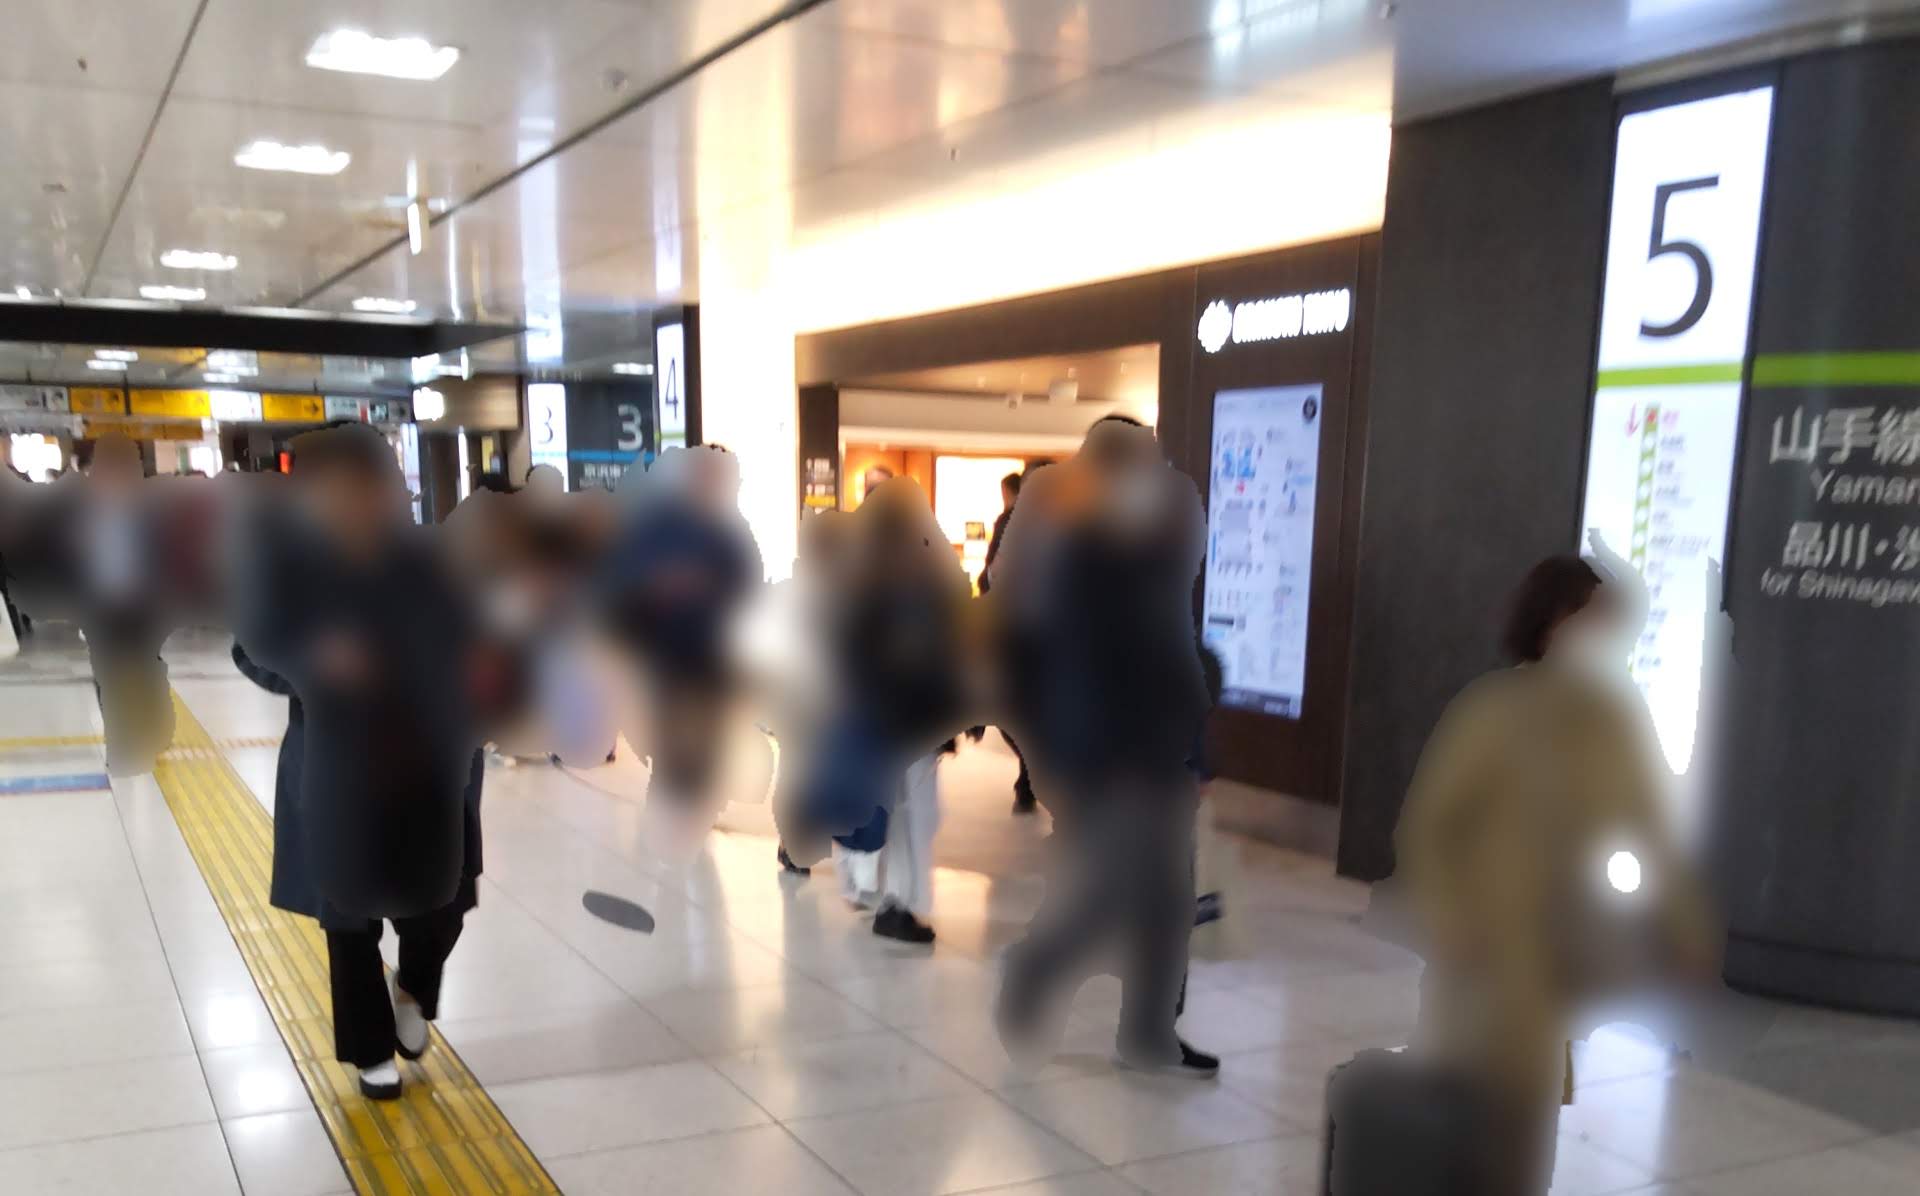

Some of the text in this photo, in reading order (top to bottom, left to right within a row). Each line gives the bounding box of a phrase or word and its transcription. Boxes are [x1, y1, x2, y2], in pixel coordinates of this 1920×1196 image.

[1640, 174, 1720, 337] 5
[665, 356, 679, 421] 4
[538, 405, 554, 445] 3
[617, 403, 644, 451] 3
